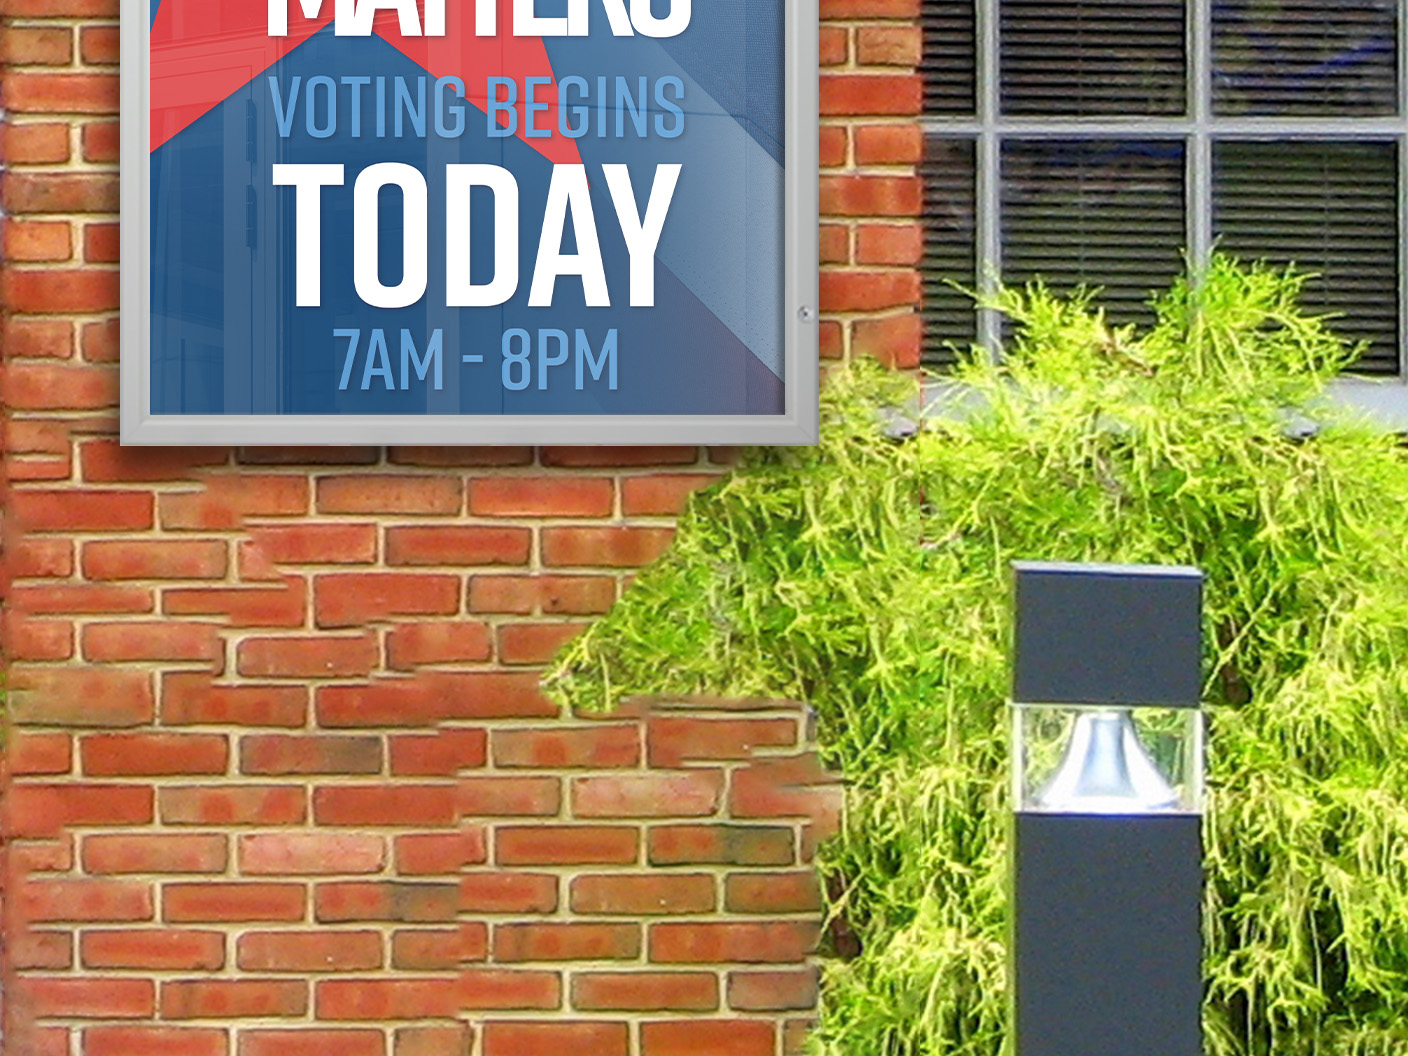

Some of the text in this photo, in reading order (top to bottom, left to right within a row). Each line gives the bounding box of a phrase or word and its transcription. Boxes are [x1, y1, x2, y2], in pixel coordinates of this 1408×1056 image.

[268, 75, 686, 139] VOTING BEGINS
[272, 162, 683, 308] TODAY
[333, 328, 444, 391] 7AM
[501, 328, 619, 392] 8PM
